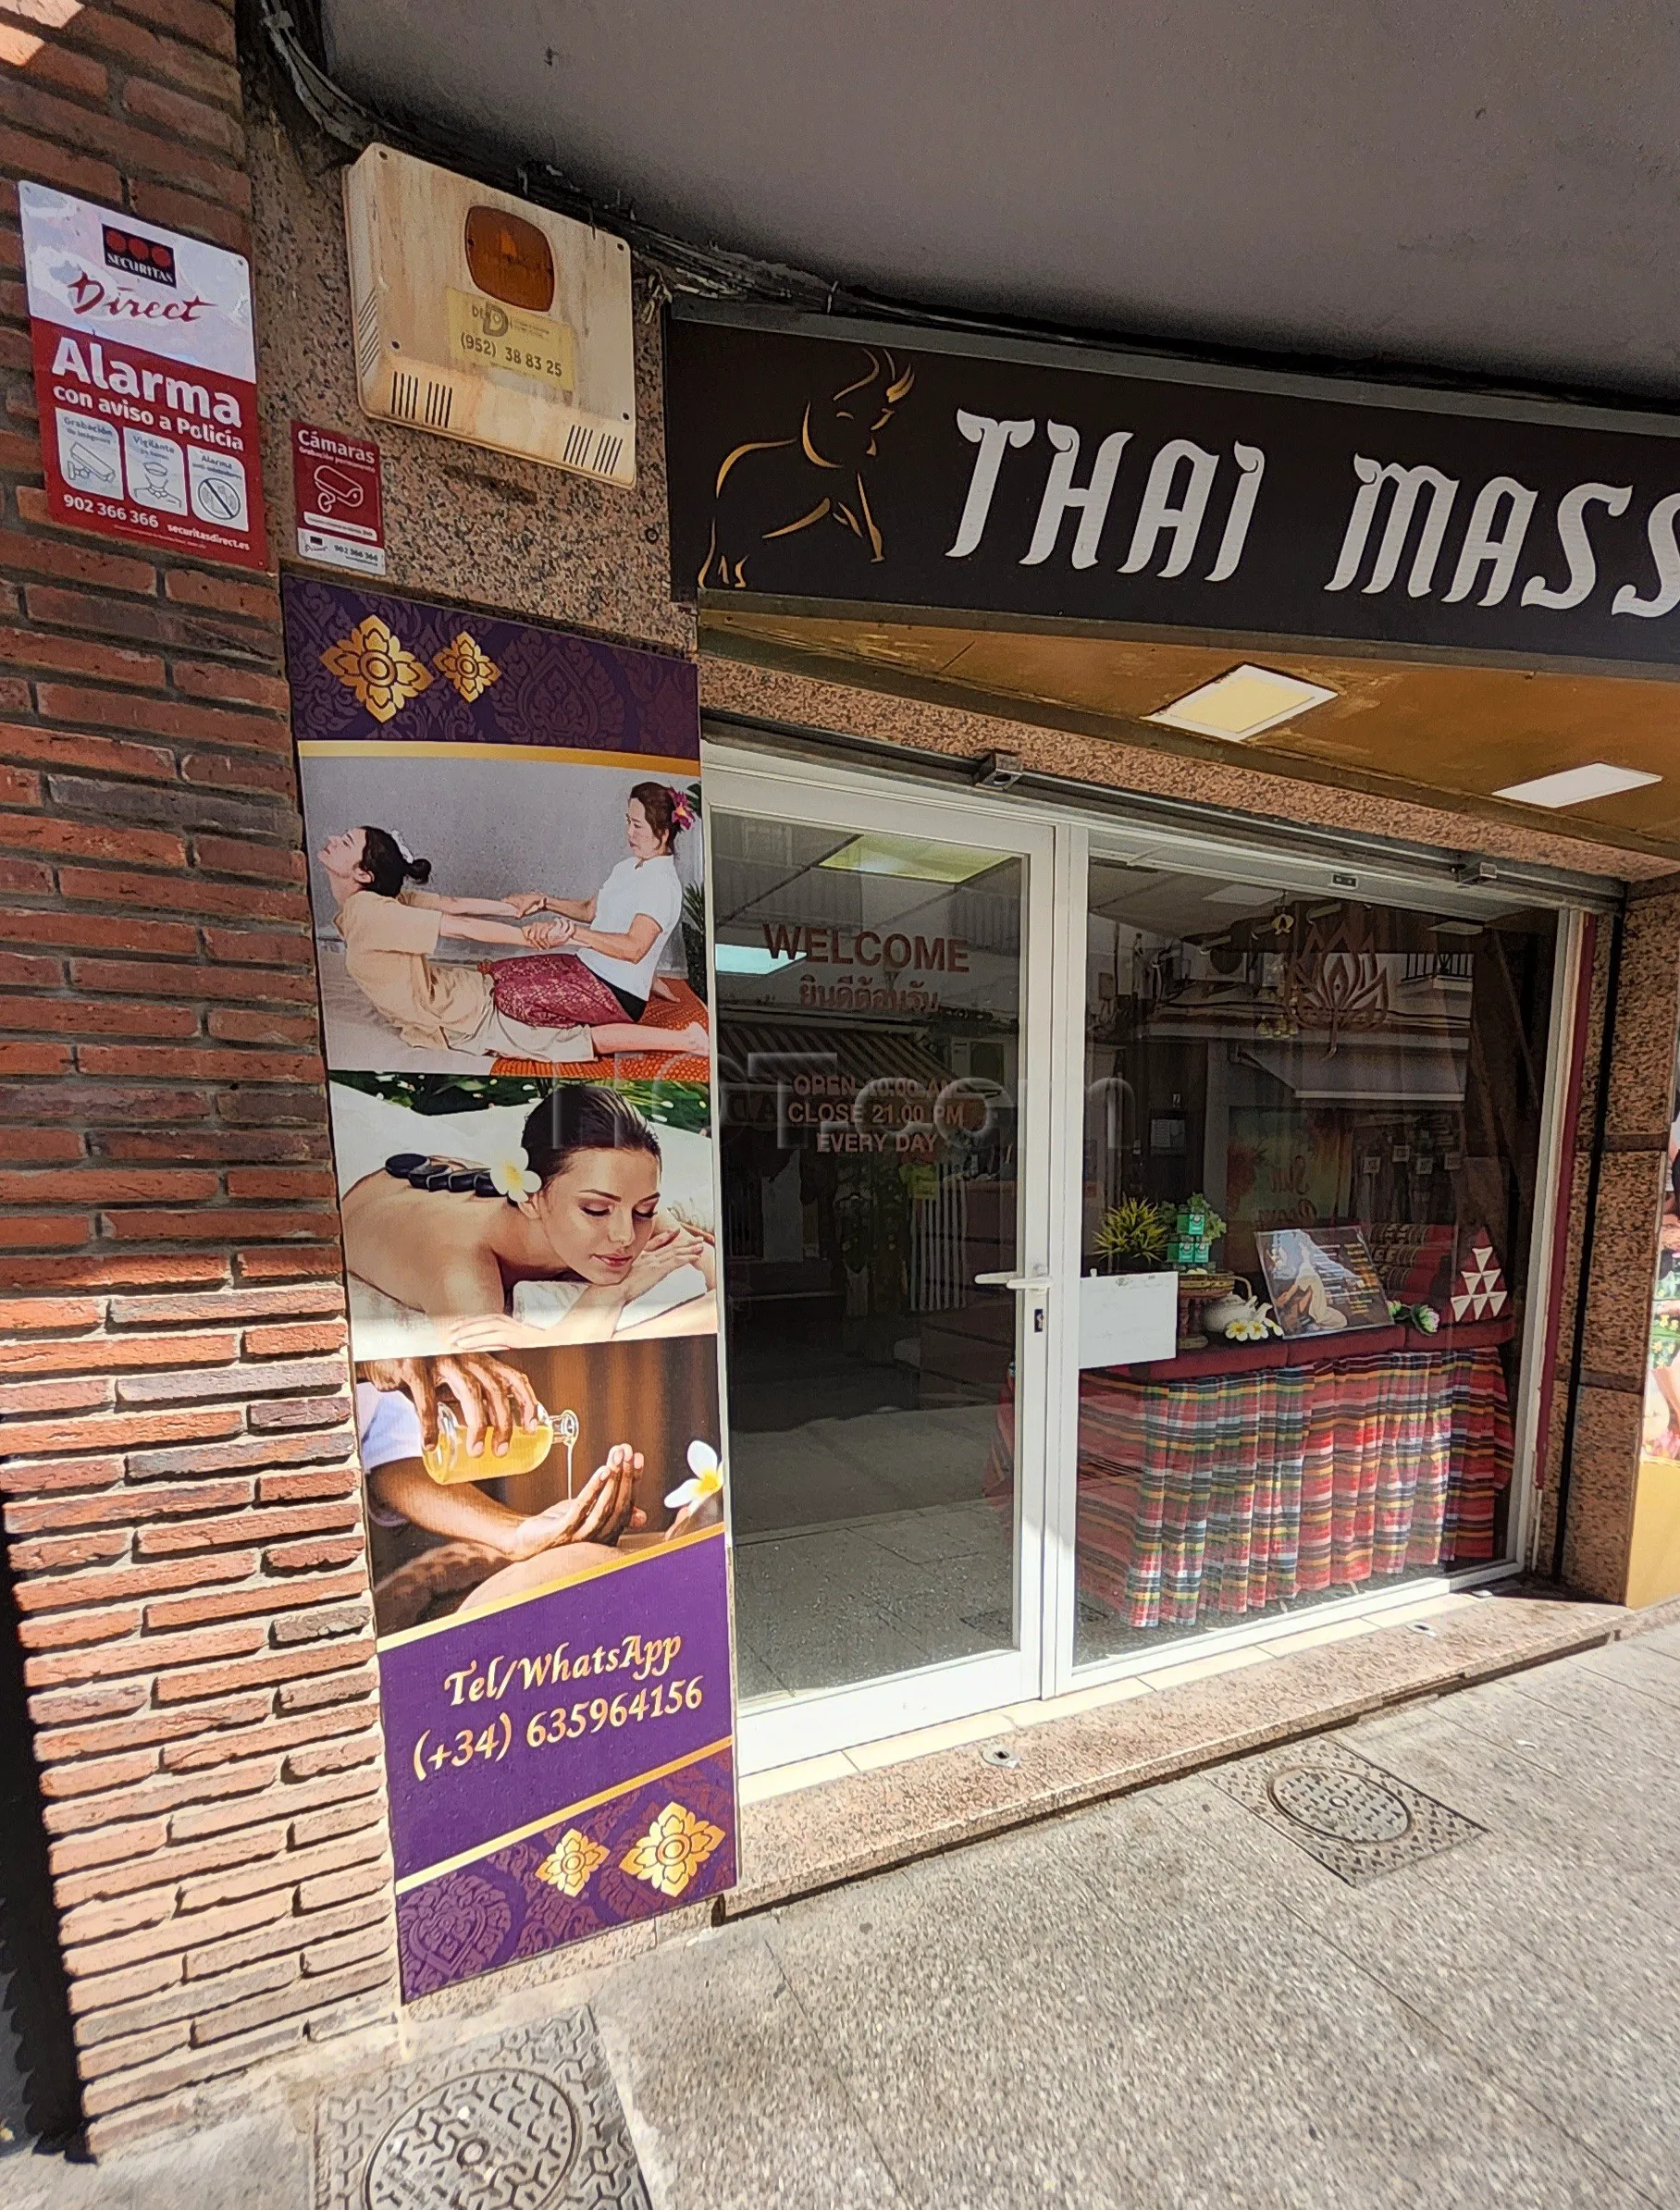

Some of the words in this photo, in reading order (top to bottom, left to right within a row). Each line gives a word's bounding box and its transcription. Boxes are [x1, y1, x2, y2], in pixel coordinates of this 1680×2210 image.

[107, 253, 174, 284] SECURITAS
[67, 271, 217, 322] Direct
[461, 332, 496, 358] (952)
[504, 346, 522, 364] 38
[525, 353, 542, 370] 83
[546, 360, 562, 377] 25
[52, 336, 242, 428] Alarma
[53, 385, 93, 409] con
[98, 397, 154, 426] aviso
[159, 414, 172, 431] a
[177, 418, 244, 451] Policía
[132, 435, 175, 453] Vigilante
[298, 429, 375, 464] Cámaras
[202, 455, 232, 469] Alarma
[63, 494, 94, 513] 902
[97, 502, 127, 521] 366
[130, 510, 159, 528] 366
[945, 408, 1266, 600] THAI
[1324, 452, 1680, 628] MASS
[167, 524, 251, 551] securitasdirect.es
[762, 923, 970, 973] WELCOME
[793, 1073, 857, 1096] OPEN
[787, 1102, 863, 1123] CLOSE
[871, 1104, 925, 1123] 21.00
[933, 1105, 964, 1126] PM
[816, 1132, 888, 1153] EVERY
[896, 1133, 940, 1153] DAY
[444, 1634, 683, 1708] Tel/WhatsApp
[413, 1711, 513, 1782] (+34)
[525, 1675, 705, 1749] 635964156
